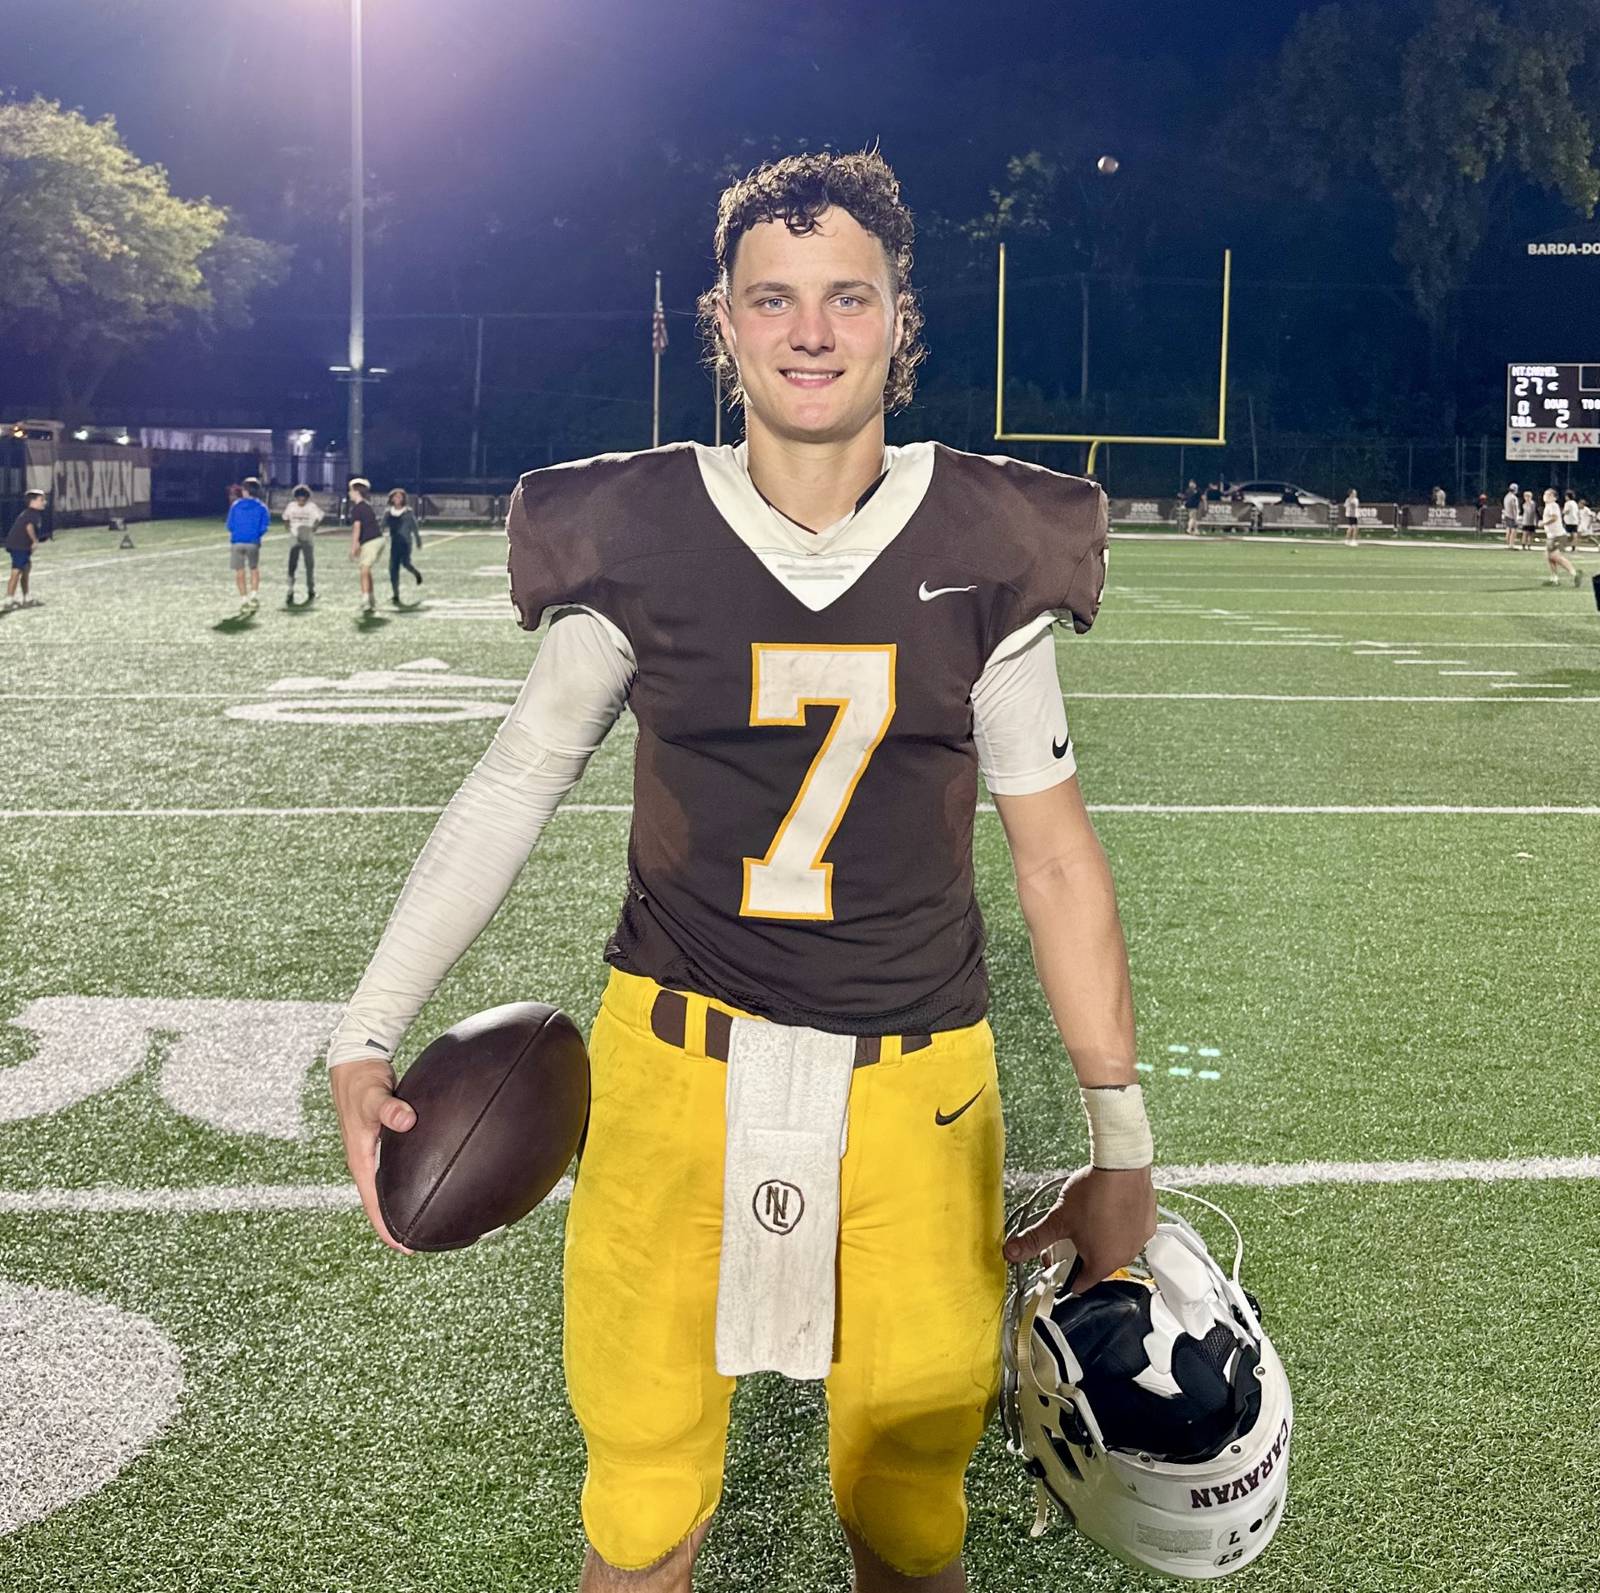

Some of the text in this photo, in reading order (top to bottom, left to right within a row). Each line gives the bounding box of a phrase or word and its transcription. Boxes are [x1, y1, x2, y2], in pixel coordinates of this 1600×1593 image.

[1515, 377, 1542, 396] 27
[1556, 409, 1569, 428] 2
[1526, 431, 1592, 444] RE/MAX
[53, 460, 133, 512] CARAVAN
[739, 643, 897, 920] 7
[1190, 1418, 1289, 1509] CARAVAN
[1228, 1530, 1241, 1545] 7
